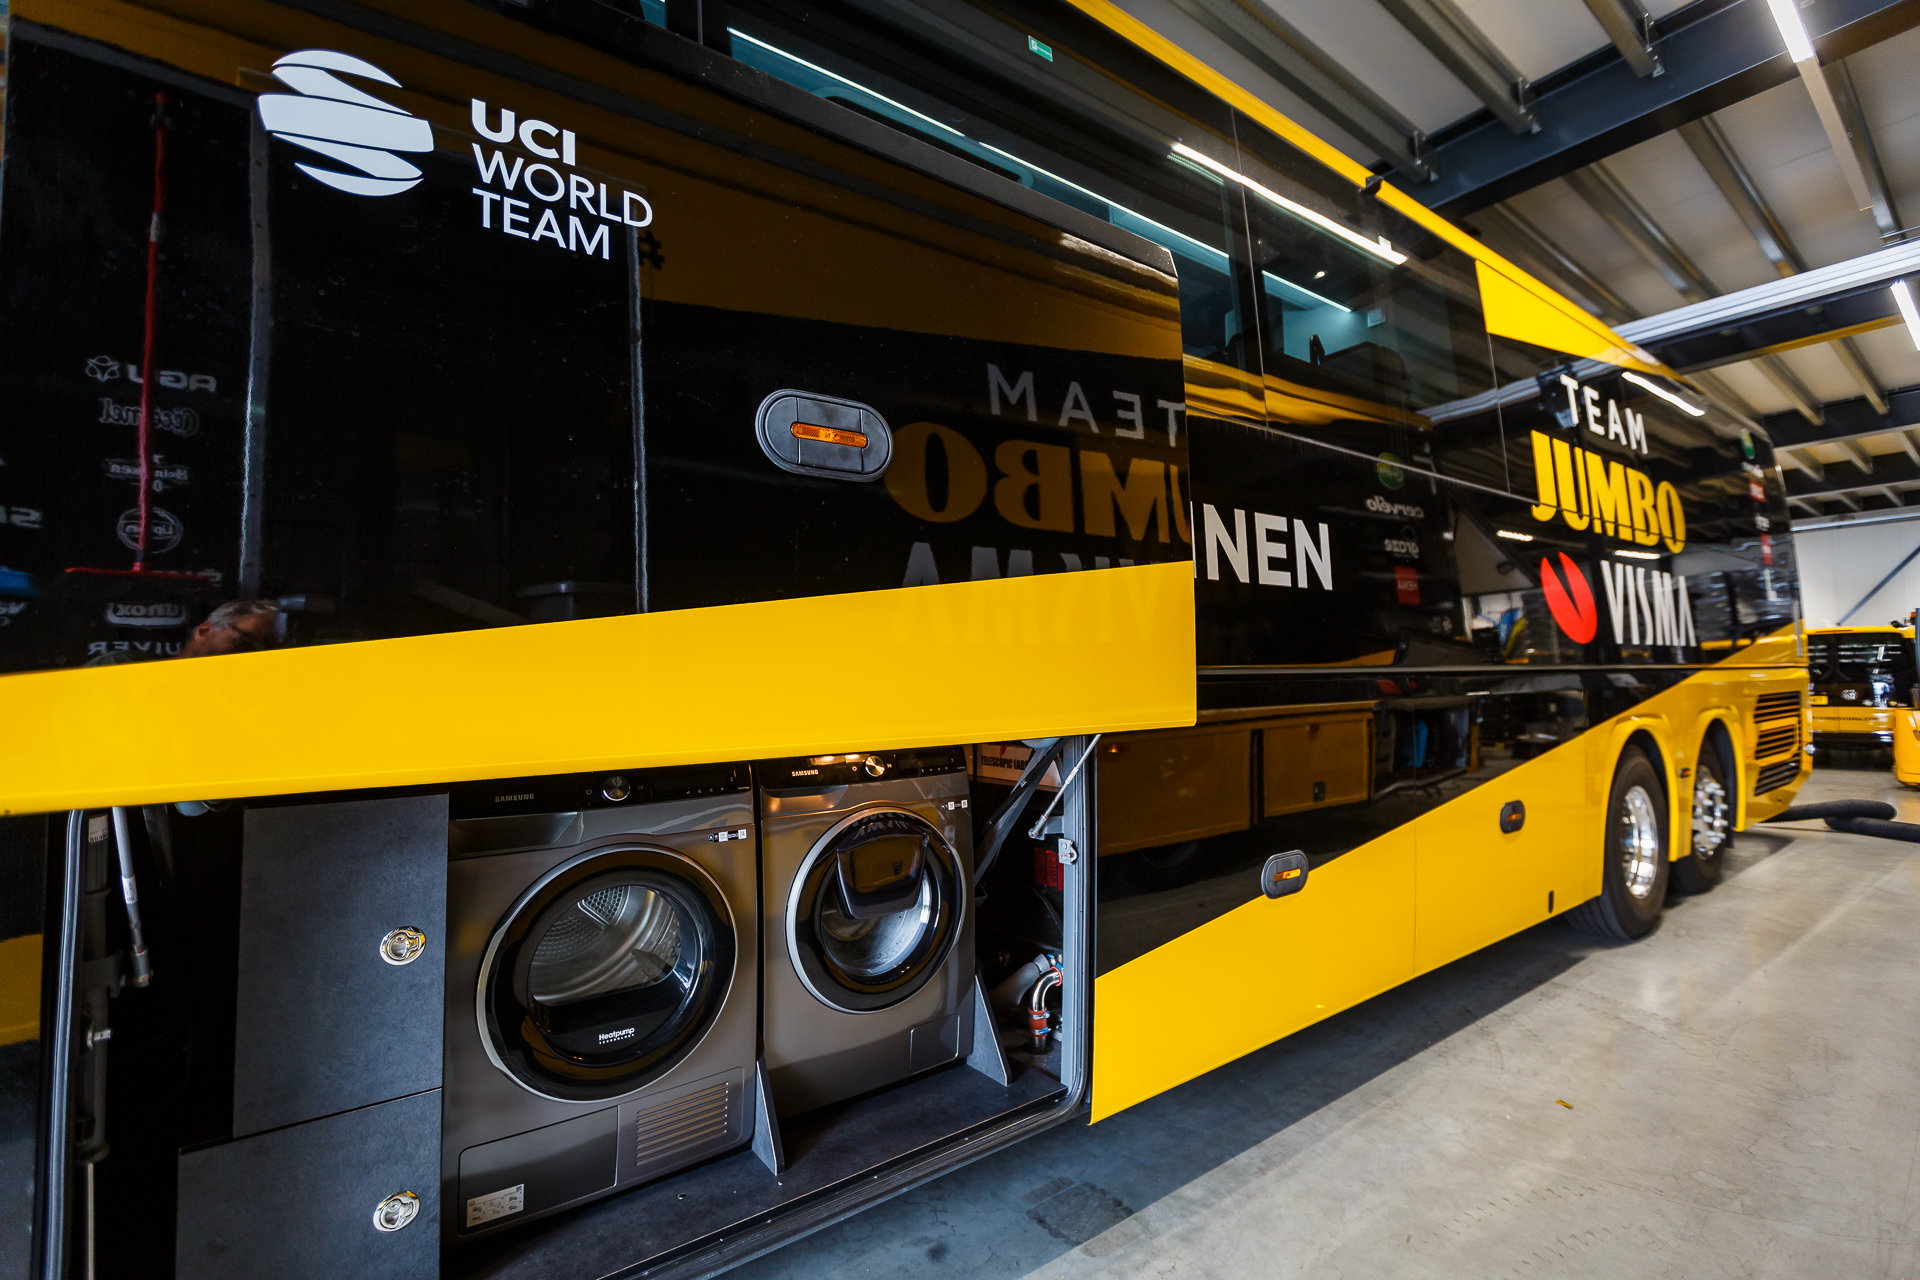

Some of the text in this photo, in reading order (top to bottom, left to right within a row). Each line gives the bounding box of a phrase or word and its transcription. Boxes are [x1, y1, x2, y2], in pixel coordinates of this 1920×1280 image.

[472, 98, 576, 167] UCI
[472, 142, 653, 228] WORLD
[472, 187, 610, 260] TEAM
[1560, 373, 1648, 455] TEAM
[1531, 429, 1686, 554] JUMBO
[1190, 501, 1333, 591] NEN
[1600, 559, 1698, 648] VISMA
[494, 793, 535, 803] SAMSUNG
[791, 769, 819, 778] SAMSUNG
[598, 1027, 636, 1042] Heatpump
